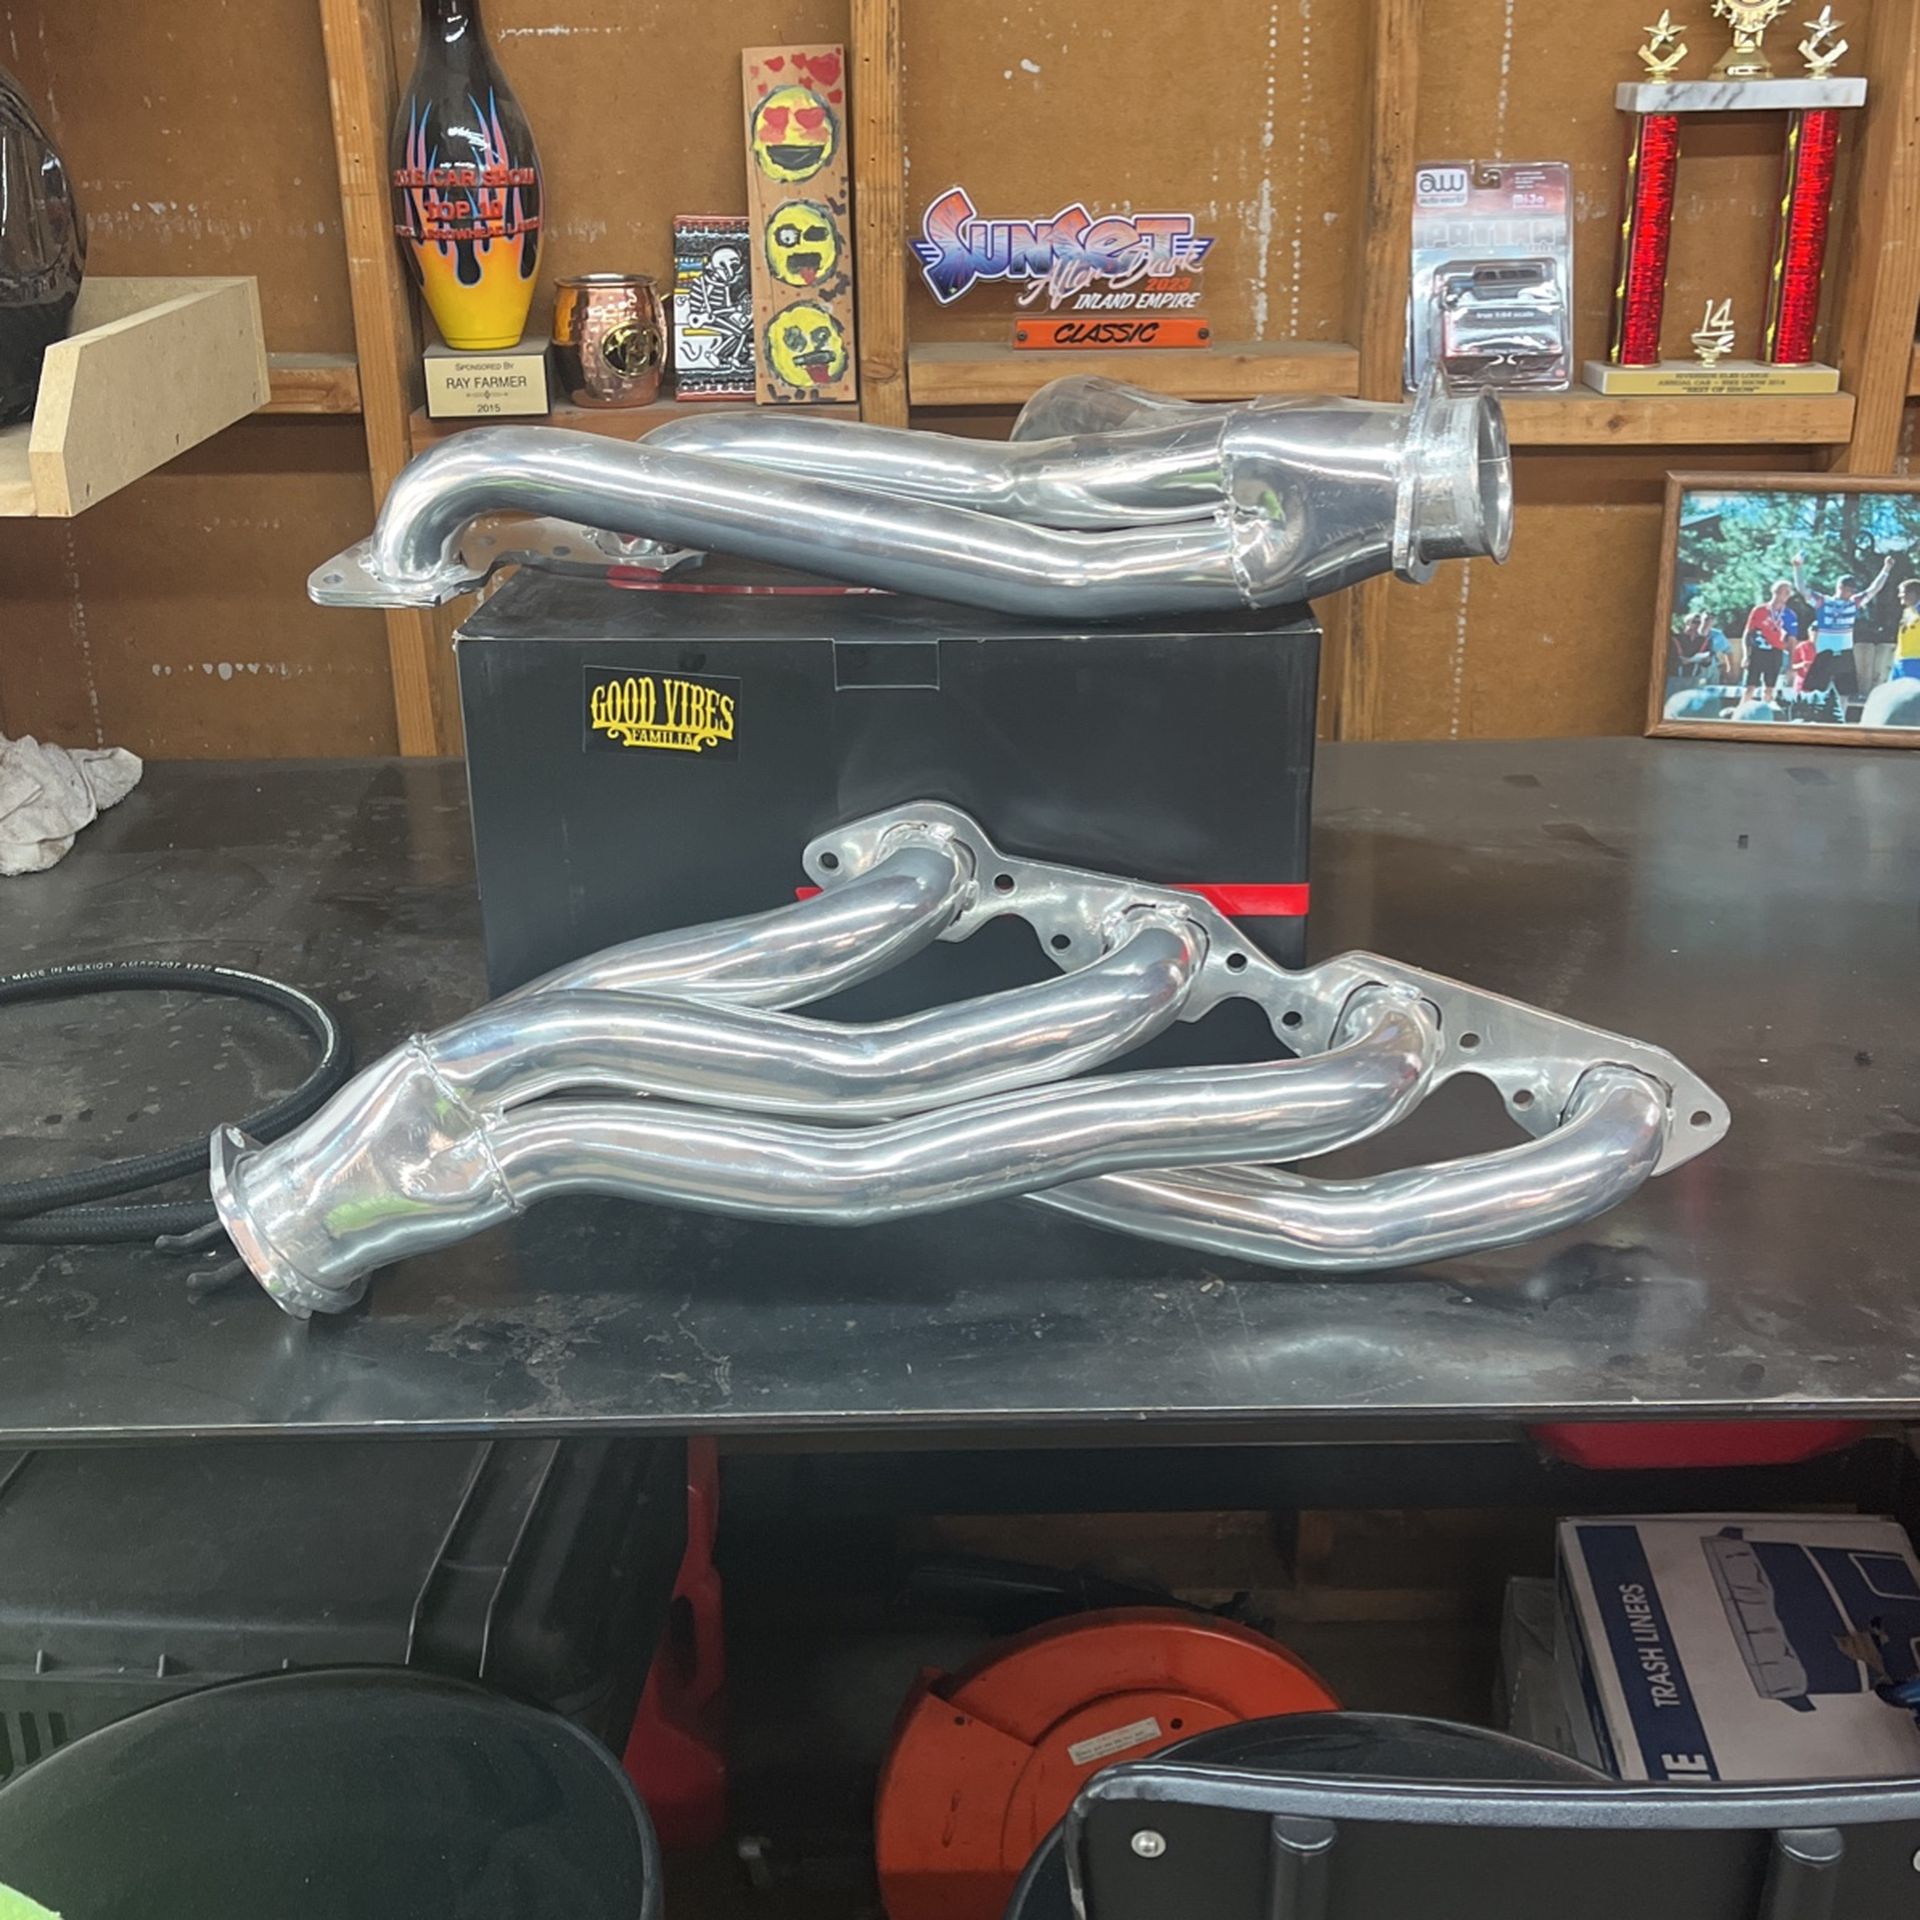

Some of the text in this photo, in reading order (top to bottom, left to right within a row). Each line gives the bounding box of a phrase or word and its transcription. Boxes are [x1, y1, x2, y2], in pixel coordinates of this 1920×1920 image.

[430, 169, 476, 186] CAR
[425, 200, 471, 220] TOP
[1145, 277, 1191, 291] 2023
[1072, 292, 1201, 310] INLAND EMPIRE
[1054, 322, 1160, 344] CLASSIC
[446, 376, 527, 389] RAY FARMER
[477, 404, 501, 413] 2015
[590, 677, 735, 732] GOOD VIBES
[633, 728, 694, 745] FAMILIA
[12, 969, 45, 981] MADE
[67, 962, 114, 972] MEXICO
[1619, 1583, 1680, 1708] TRASH LINERS
